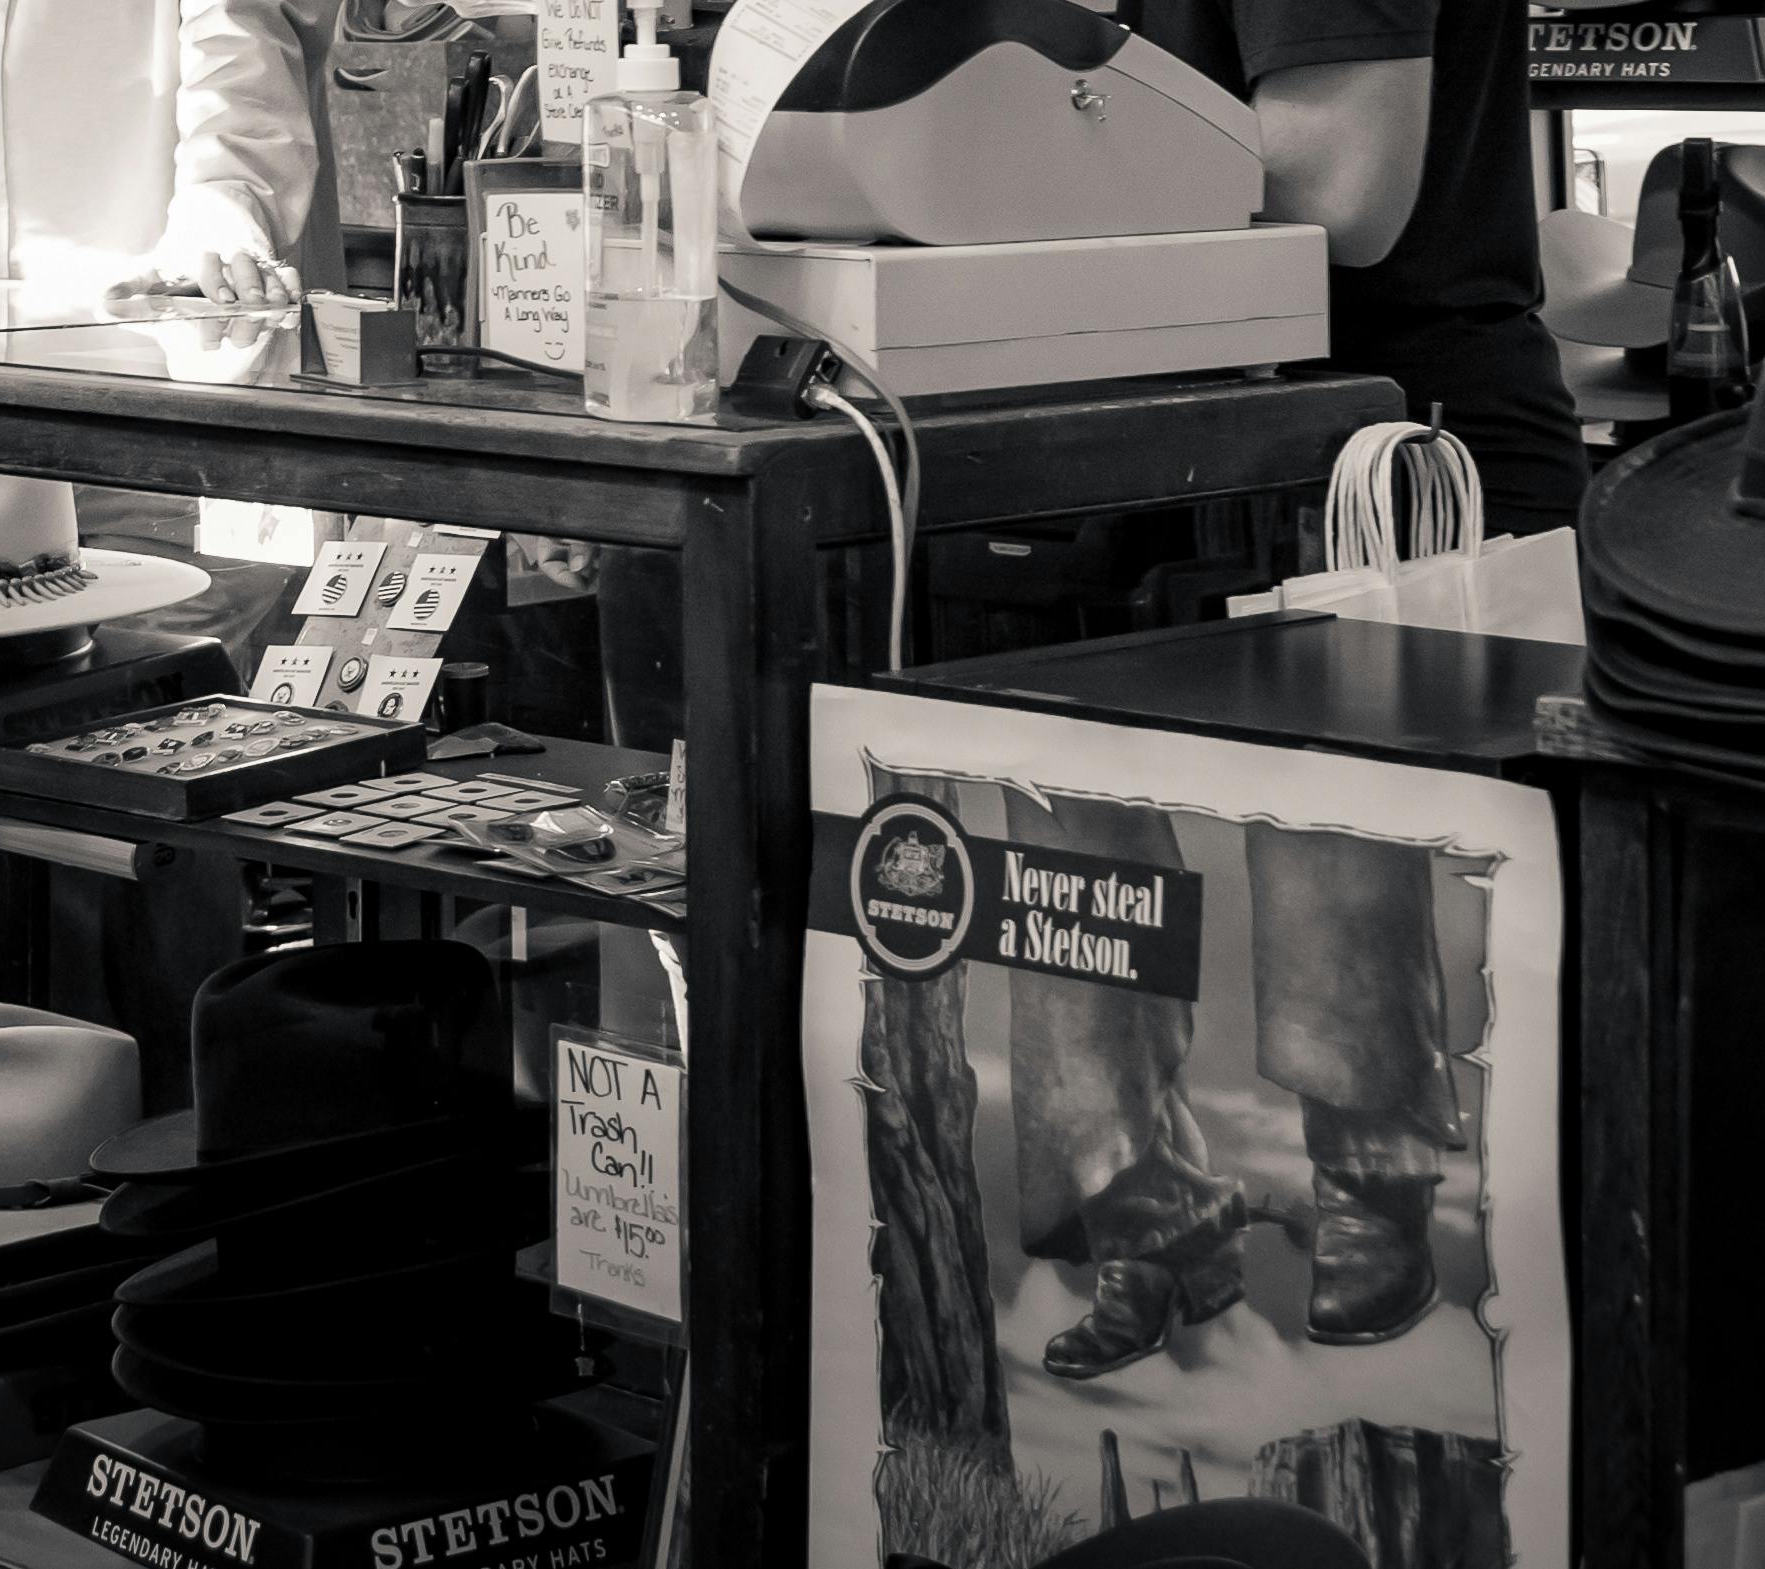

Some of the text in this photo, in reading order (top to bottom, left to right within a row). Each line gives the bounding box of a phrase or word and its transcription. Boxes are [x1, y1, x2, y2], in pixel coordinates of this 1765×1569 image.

[1529, 20, 1699, 53] TETSON
[1529, 61, 1671, 78] GENDARY HATS
[496, 201, 541, 239] Be
[493, 239, 557, 282] Kind
[492, 284, 571, 303] Manners Go
[516, 307, 542, 333] Long
[1001, 849, 1165, 929] Never steal
[866, 898, 955, 931] STETSON
[998, 909, 1139, 981] a Stetson.
[567, 1047, 662, 1111] NOT A
[560, 1098, 638, 1155] Trash
[591, 1140, 655, 1192] Can!!
[570, 1206, 607, 1233] are
[86, 1452, 262, 1566] STETSON
[370, 1473, 622, 1569] STETSON
[91, 1515, 184, 1569] LEGENDARY
[549, 1538, 607, 1569] HATS
